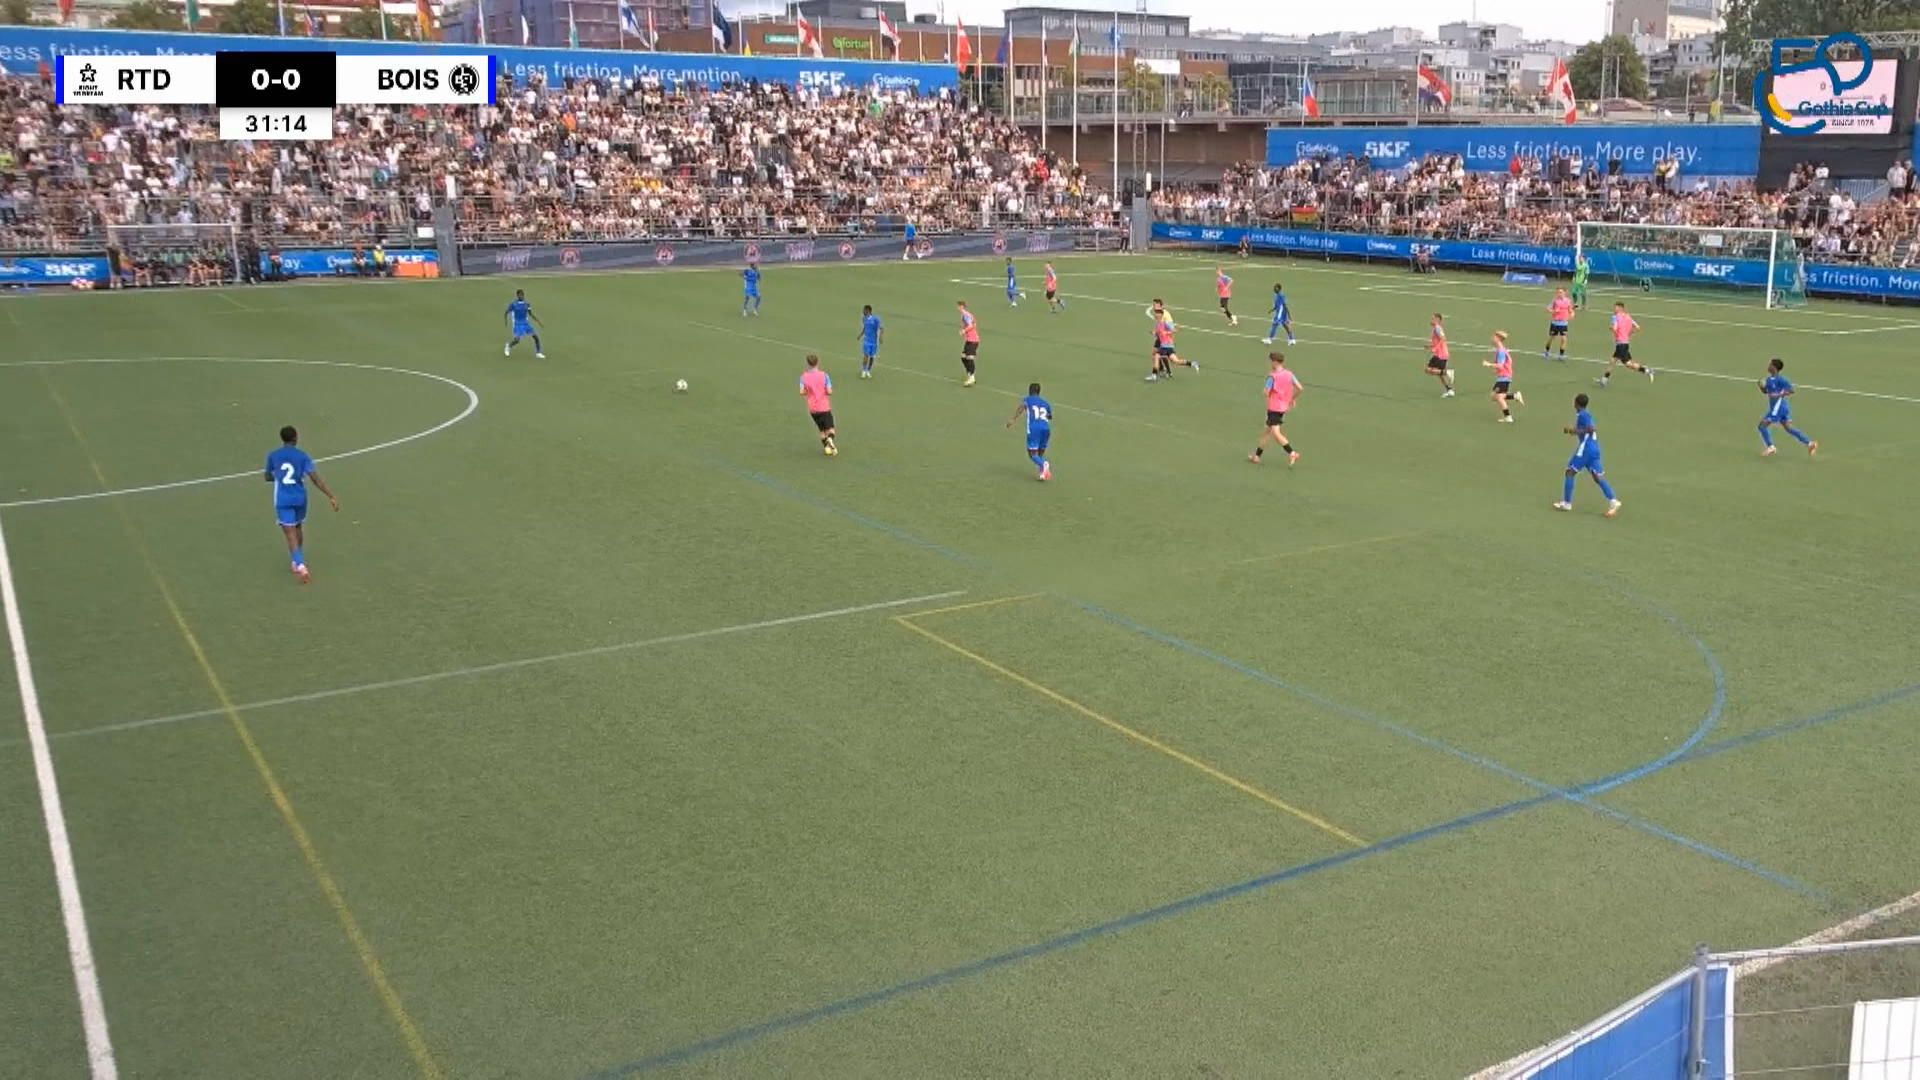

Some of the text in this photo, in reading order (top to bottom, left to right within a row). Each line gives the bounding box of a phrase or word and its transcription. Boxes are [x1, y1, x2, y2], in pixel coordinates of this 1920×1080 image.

[0, 45, 42, 60] ess
[633, 64, 676, 81] More
[800, 70, 846, 87] SKF
[1364, 141, 1410, 158] SKF
[1466, 141, 1507, 159] Less
[1596, 141, 1646, 160] More
[1652, 141, 1703, 166] play.
[1300, 235, 1320, 247] More
[1410, 243, 1441, 256] SF
[1472, 247, 1496, 260] Less
[1497, 249, 1540, 264] friction.
[1543, 252, 1572, 266] More
[45, 262, 97, 277] SKF
[1693, 262, 1736, 277] SKF
[1822, 271, 1883, 289] friction.
[1888, 274, 1920, 291] Mor
[1032, 404, 1049, 422] 12
[280, 462, 296, 484] 2
